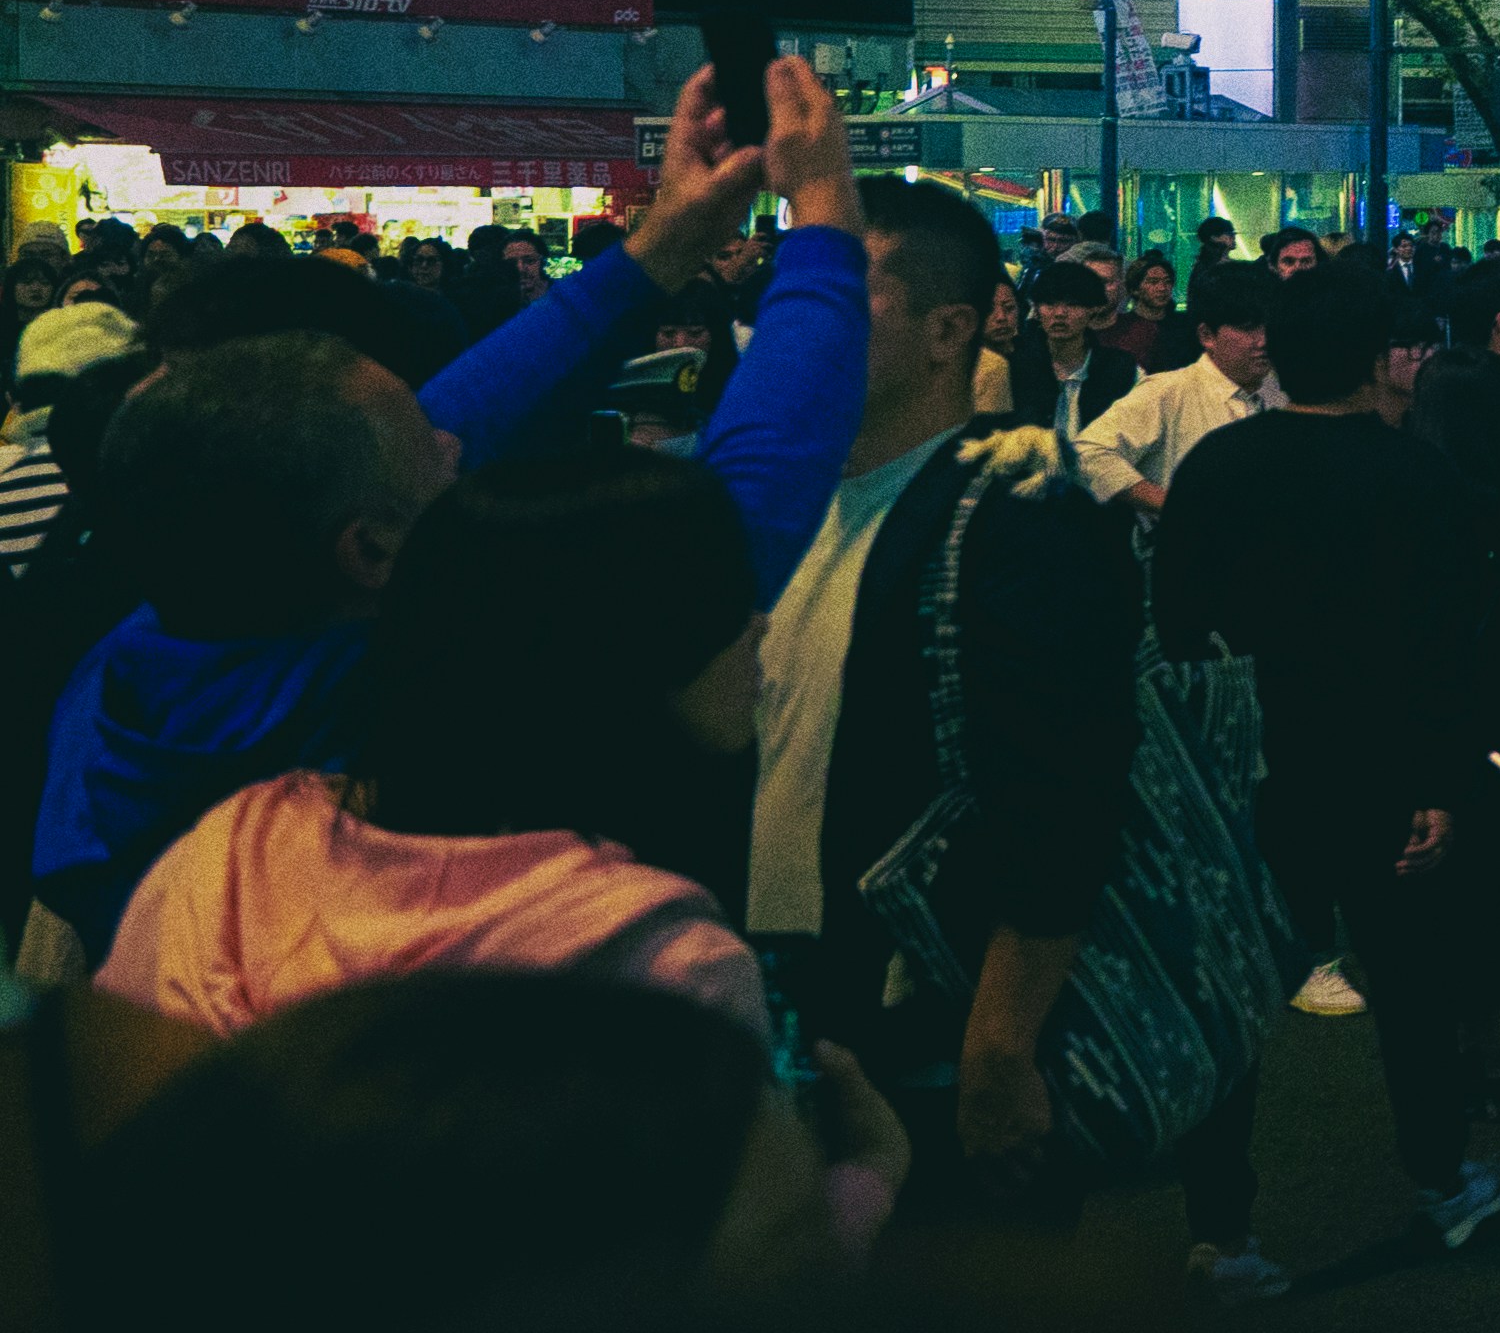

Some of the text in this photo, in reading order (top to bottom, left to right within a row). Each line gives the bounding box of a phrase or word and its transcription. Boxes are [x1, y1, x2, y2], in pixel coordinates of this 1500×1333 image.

[172, 159, 292, 184] SANZENRI
[328, 162, 483, 182] ハチ公前のくすり屋さん
[490, 160, 612, 185] 三千里薬品
